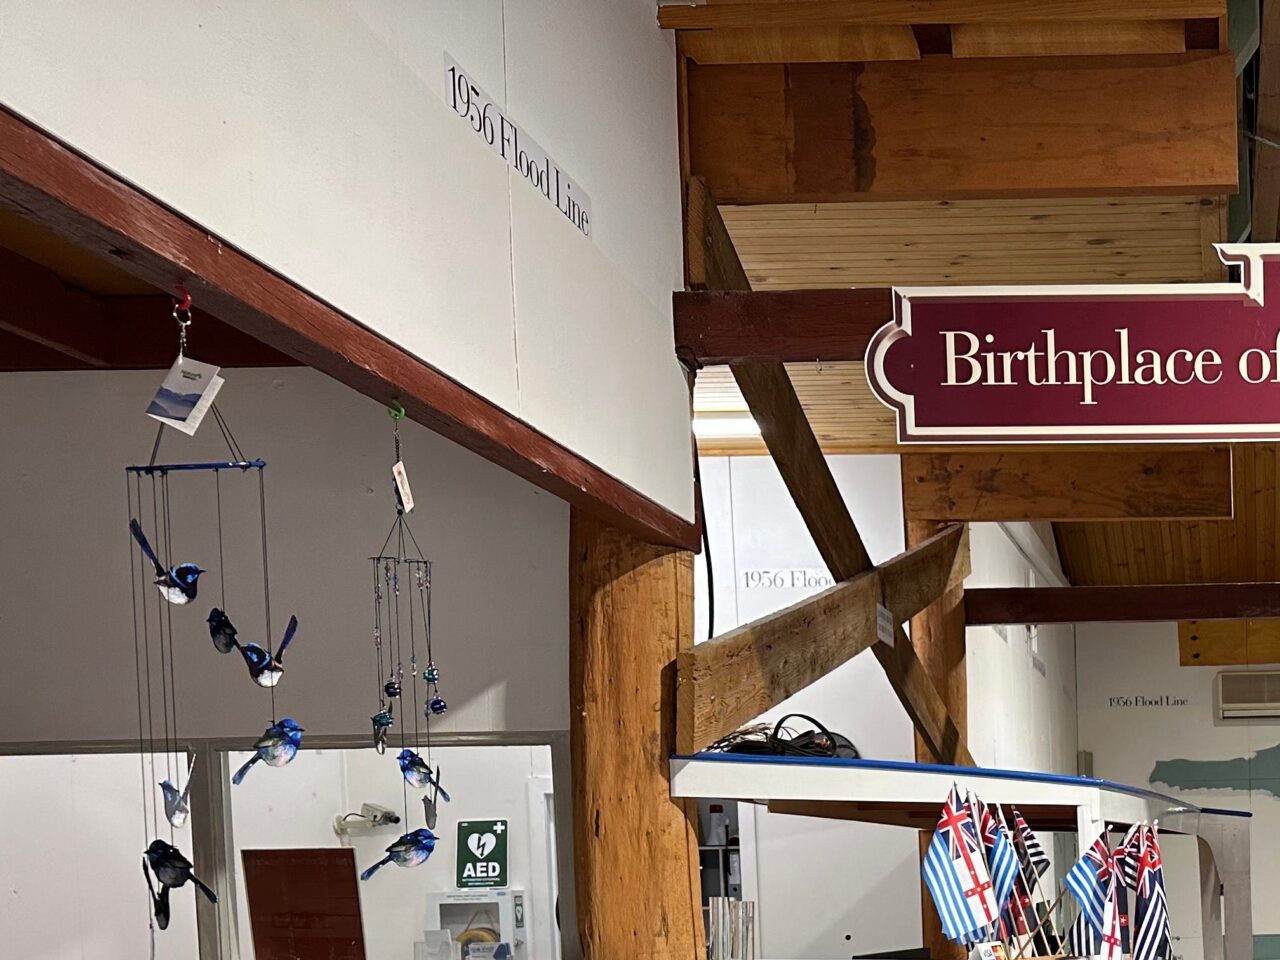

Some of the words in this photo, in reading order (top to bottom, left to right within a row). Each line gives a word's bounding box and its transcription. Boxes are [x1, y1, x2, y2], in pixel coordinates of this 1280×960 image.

[448, 66, 494, 145] 1956
[498, 112, 551, 200] Flood
[553, 166, 589, 236] Line
[939, 328, 1223, 406] Birthplace
[744, 571, 784, 588] 1956
[1109, 696, 1133, 707] 1956
[1135, 695, 1163, 707] Flood
[463, 862, 500, 877] AED
